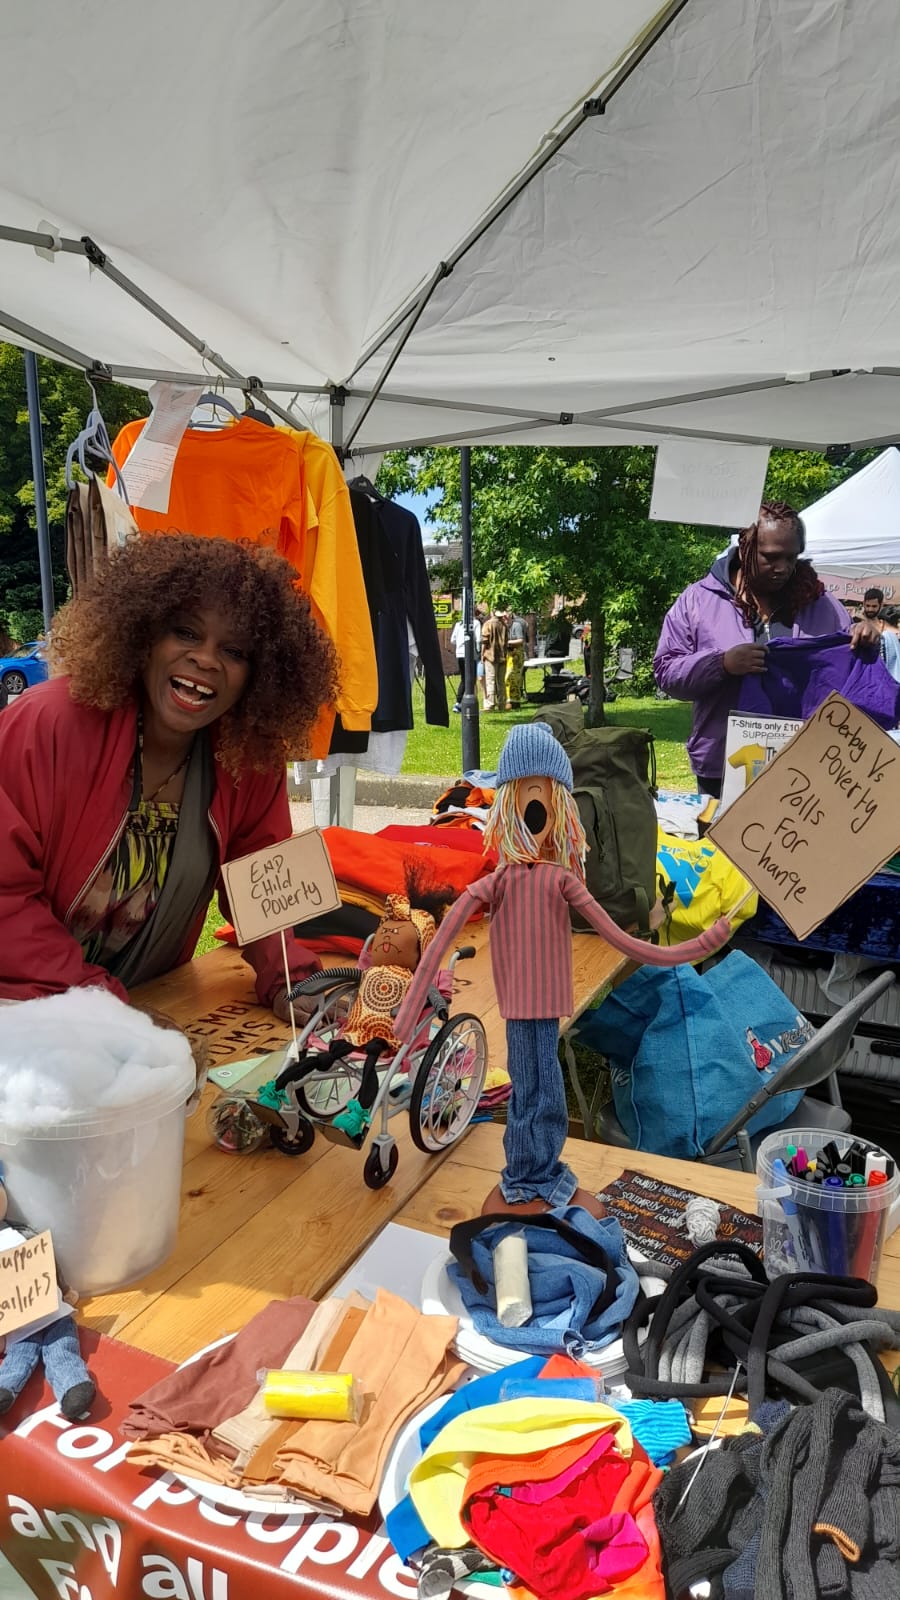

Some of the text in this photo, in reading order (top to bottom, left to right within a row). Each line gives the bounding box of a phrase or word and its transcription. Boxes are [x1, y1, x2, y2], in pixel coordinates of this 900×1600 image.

[731, 719, 800, 732] T-Shirts only £10
[742, 730, 786, 740] SUPPORT
[818, 700, 896, 783] Derby Vs
[780, 767, 825, 826] Dolls
[250, 854, 284, 884] END
[741, 822, 807, 904] Change
[0, 1238, 49, 1273] upport
[7, 1494, 122, 1588] and
[141, 1554, 229, 1600] all
